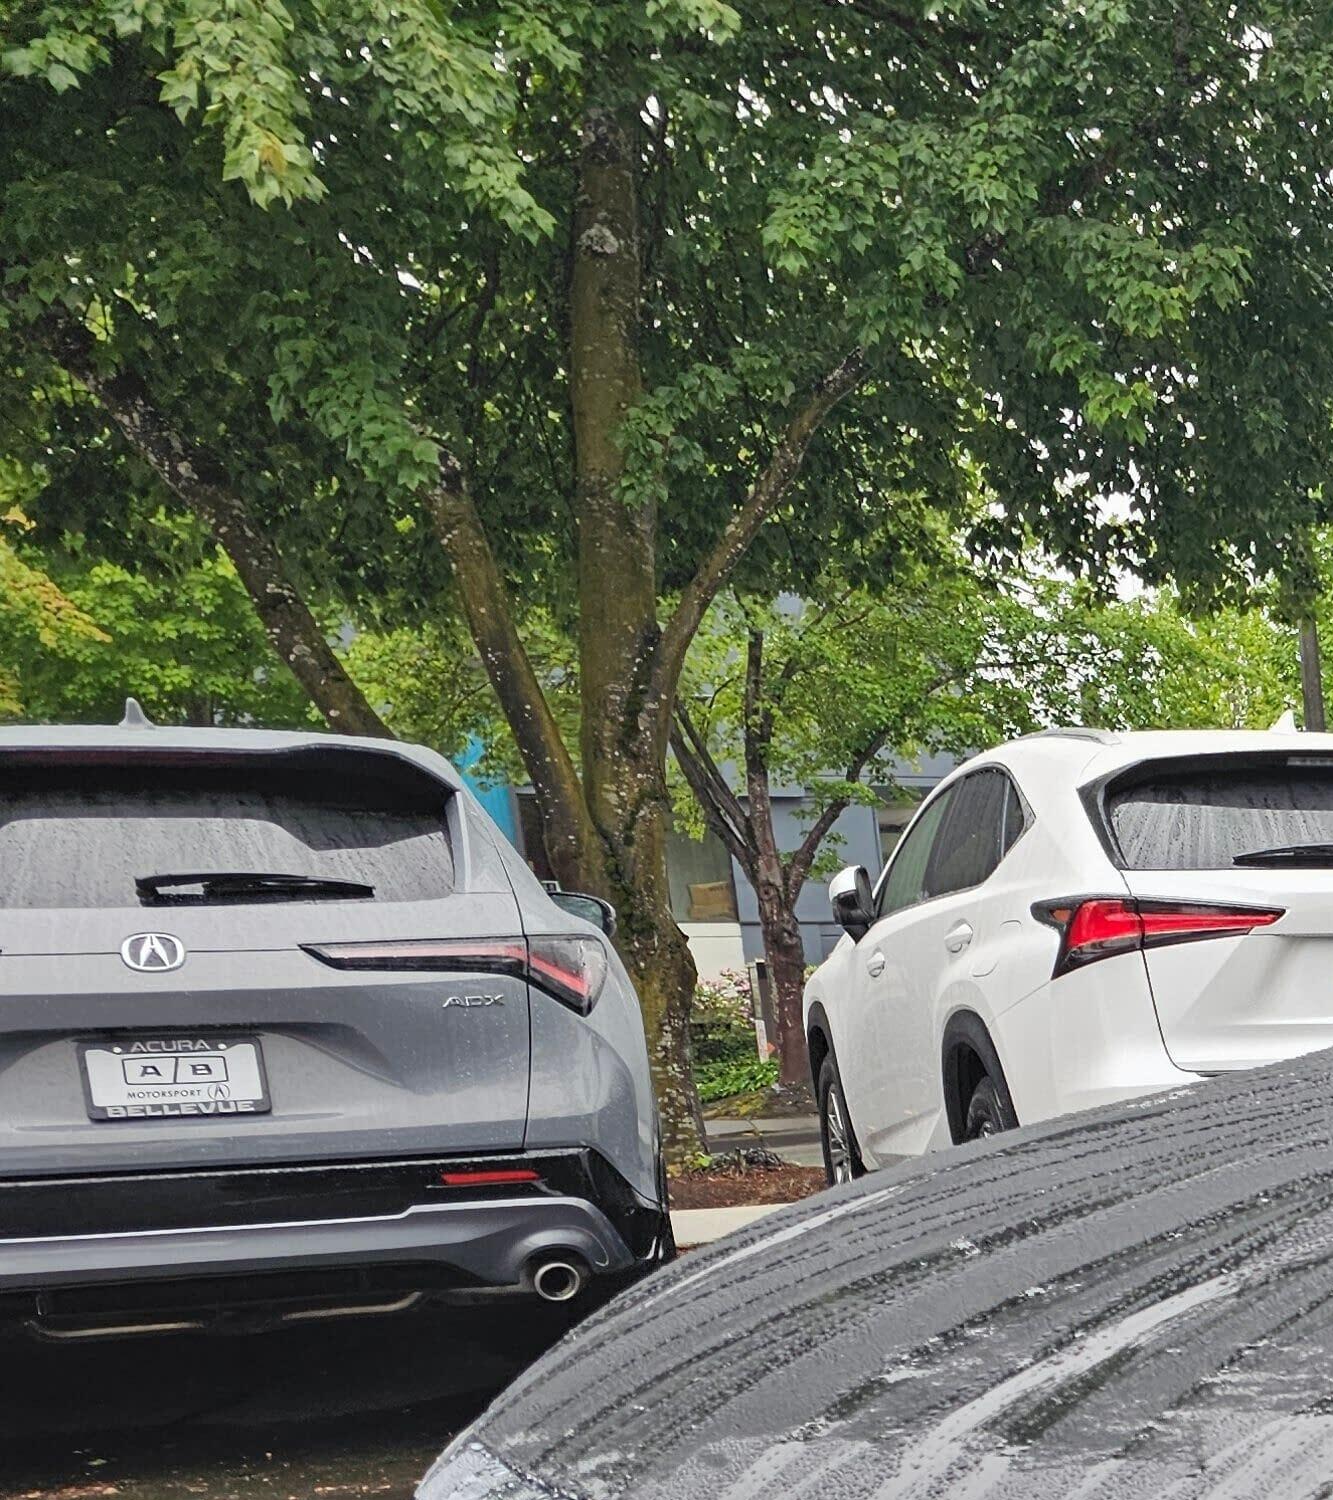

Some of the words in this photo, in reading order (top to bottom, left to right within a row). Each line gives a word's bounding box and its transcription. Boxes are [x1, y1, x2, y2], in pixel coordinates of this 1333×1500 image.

[442, 994, 504, 1008] ADX
[131, 1040, 211, 1053] ACURA
[140, 1064, 162, 1077] A
[189, 1063, 212, 1076] B
[127, 1088, 201, 1099] MOTORSPORT
[106, 1101, 255, 1118] BELLEVUE
